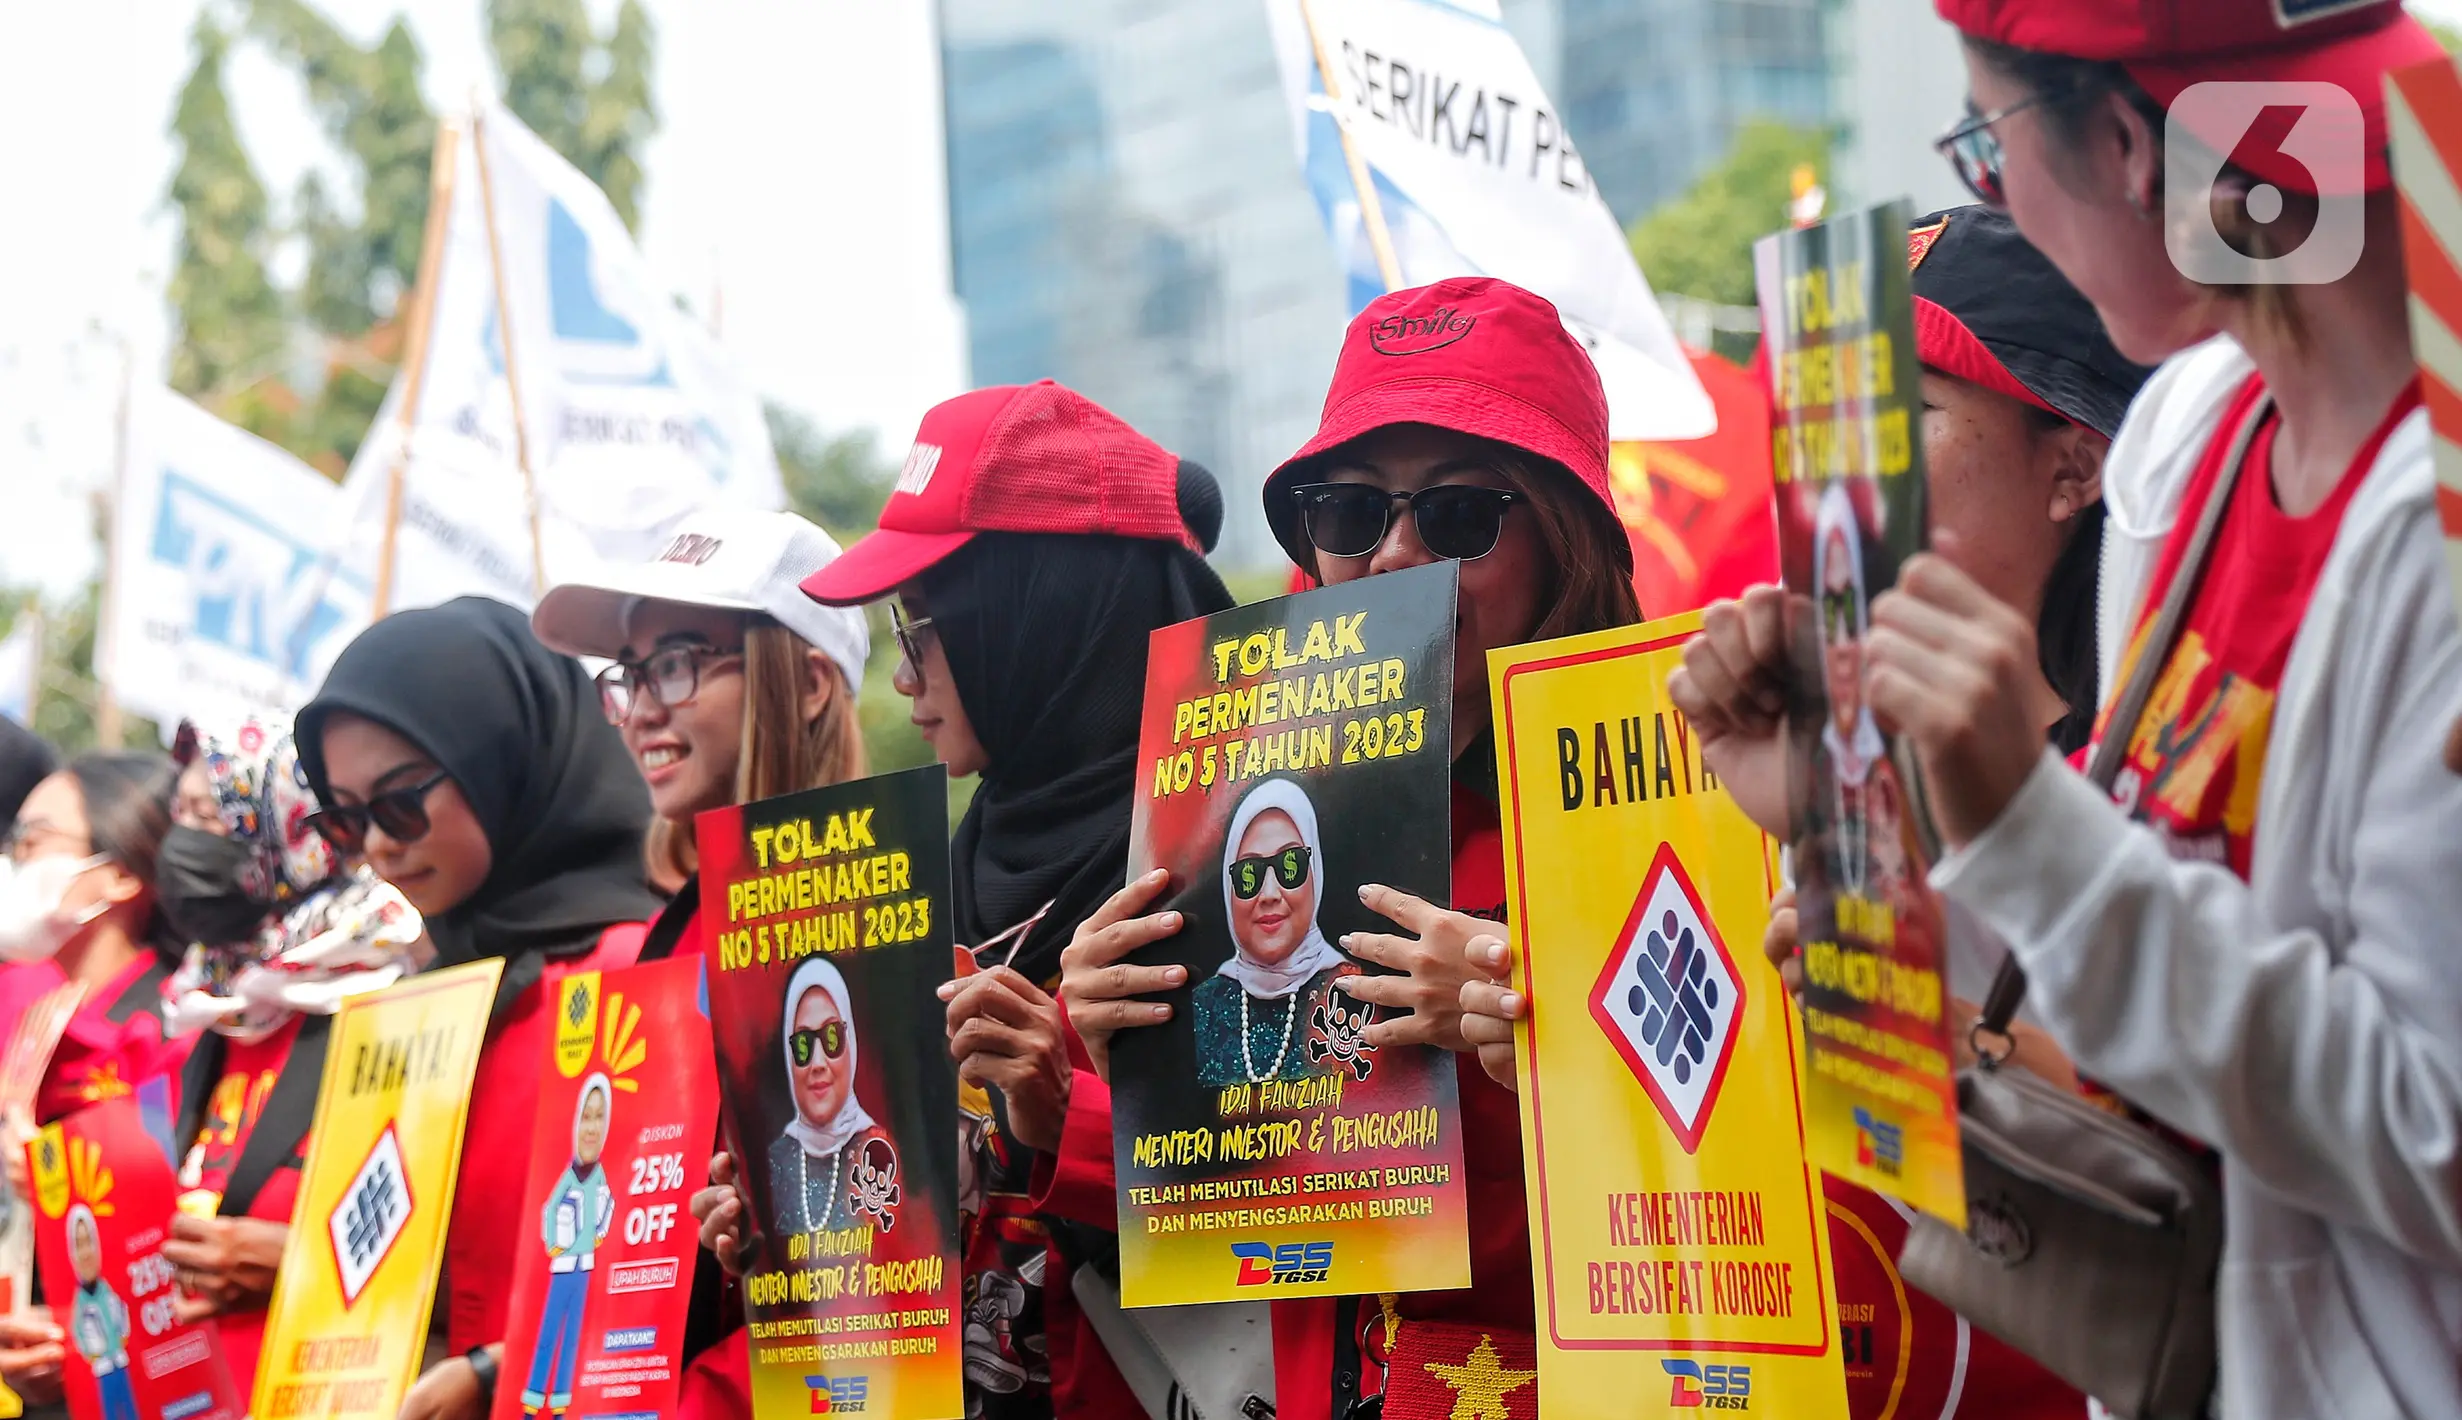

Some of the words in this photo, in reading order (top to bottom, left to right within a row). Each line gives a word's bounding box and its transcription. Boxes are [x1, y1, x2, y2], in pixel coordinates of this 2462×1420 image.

[1342, 38, 1517, 168] SERIKAT
[1213, 610, 1368, 684] TOLAK
[1173, 658, 1405, 744] PERMENAKER
[1153, 749, 1194, 798] NO
[1199, 745, 1217, 787] 5
[1224, 723, 1334, 782] TAHUN
[1340, 707, 1427, 766] 2023
[753, 807, 876, 868] TOLAK
[728, 852, 911, 922] PERMENAKER
[719, 928, 752, 972] NO
[757, 926, 771, 964] 5
[775, 910, 856, 960] TAHUN
[863, 898, 930, 948] 2023
[1219, 1081, 1250, 1115] IDA
[1259, 1071, 1344, 1114] FAUZIAH
[640, 1124, 684, 1144] DISKON
[1133, 1127, 1213, 1169] MENTERI
[1220, 1118, 1301, 1162] INVESTOR
[1308, 1112, 1325, 1151] &
[1331, 1105, 1439, 1154] PENGUSAHA
[629, 1152, 685, 1196] 25%
[1129, 1185, 1186, 1206] TELAH
[1190, 1176, 1298, 1202] MEMUTILASI
[1303, 1170, 1378, 1193] SERIKAT
[1385, 1164, 1450, 1187] BURUH
[624, 1203, 678, 1246] OFF
[1147, 1213, 1185, 1234] DAN
[1190, 1202, 1364, 1231] MENYENGSARAKAN
[1369, 1196, 1433, 1218] BURUH
[1607, 1190, 1766, 1247] KEMENTERIAN
[788, 1233, 810, 1262] IDA
[815, 1222, 876, 1258] FAUZIAH
[614, 1270, 641, 1286] UPAH
[641, 1266, 674, 1283] BURUH
[792, 1262, 845, 1303] INVESTOR
[849, 1260, 861, 1296] &
[864, 1254, 944, 1298] PENGUSAHA
[1271, 1269, 1328, 1284] TGSL
[1588, 1260, 1704, 1316] BERSIFAT
[1710, 1260, 1793, 1319] KOROSIF
[750, 1322, 776, 1339] TELAH
[778, 1316, 842, 1337] MEMUTILASI
[846, 1312, 899, 1332] SERIKAT
[903, 1308, 950, 1328] BURUH
[760, 1347, 779, 1364] DAN
[780, 1341, 888, 1363] MENYENGSARAKAN
[891, 1336, 937, 1356] BURUH
[831, 1401, 866, 1413] TGSL
[1705, 1395, 1749, 1411] TGSL
